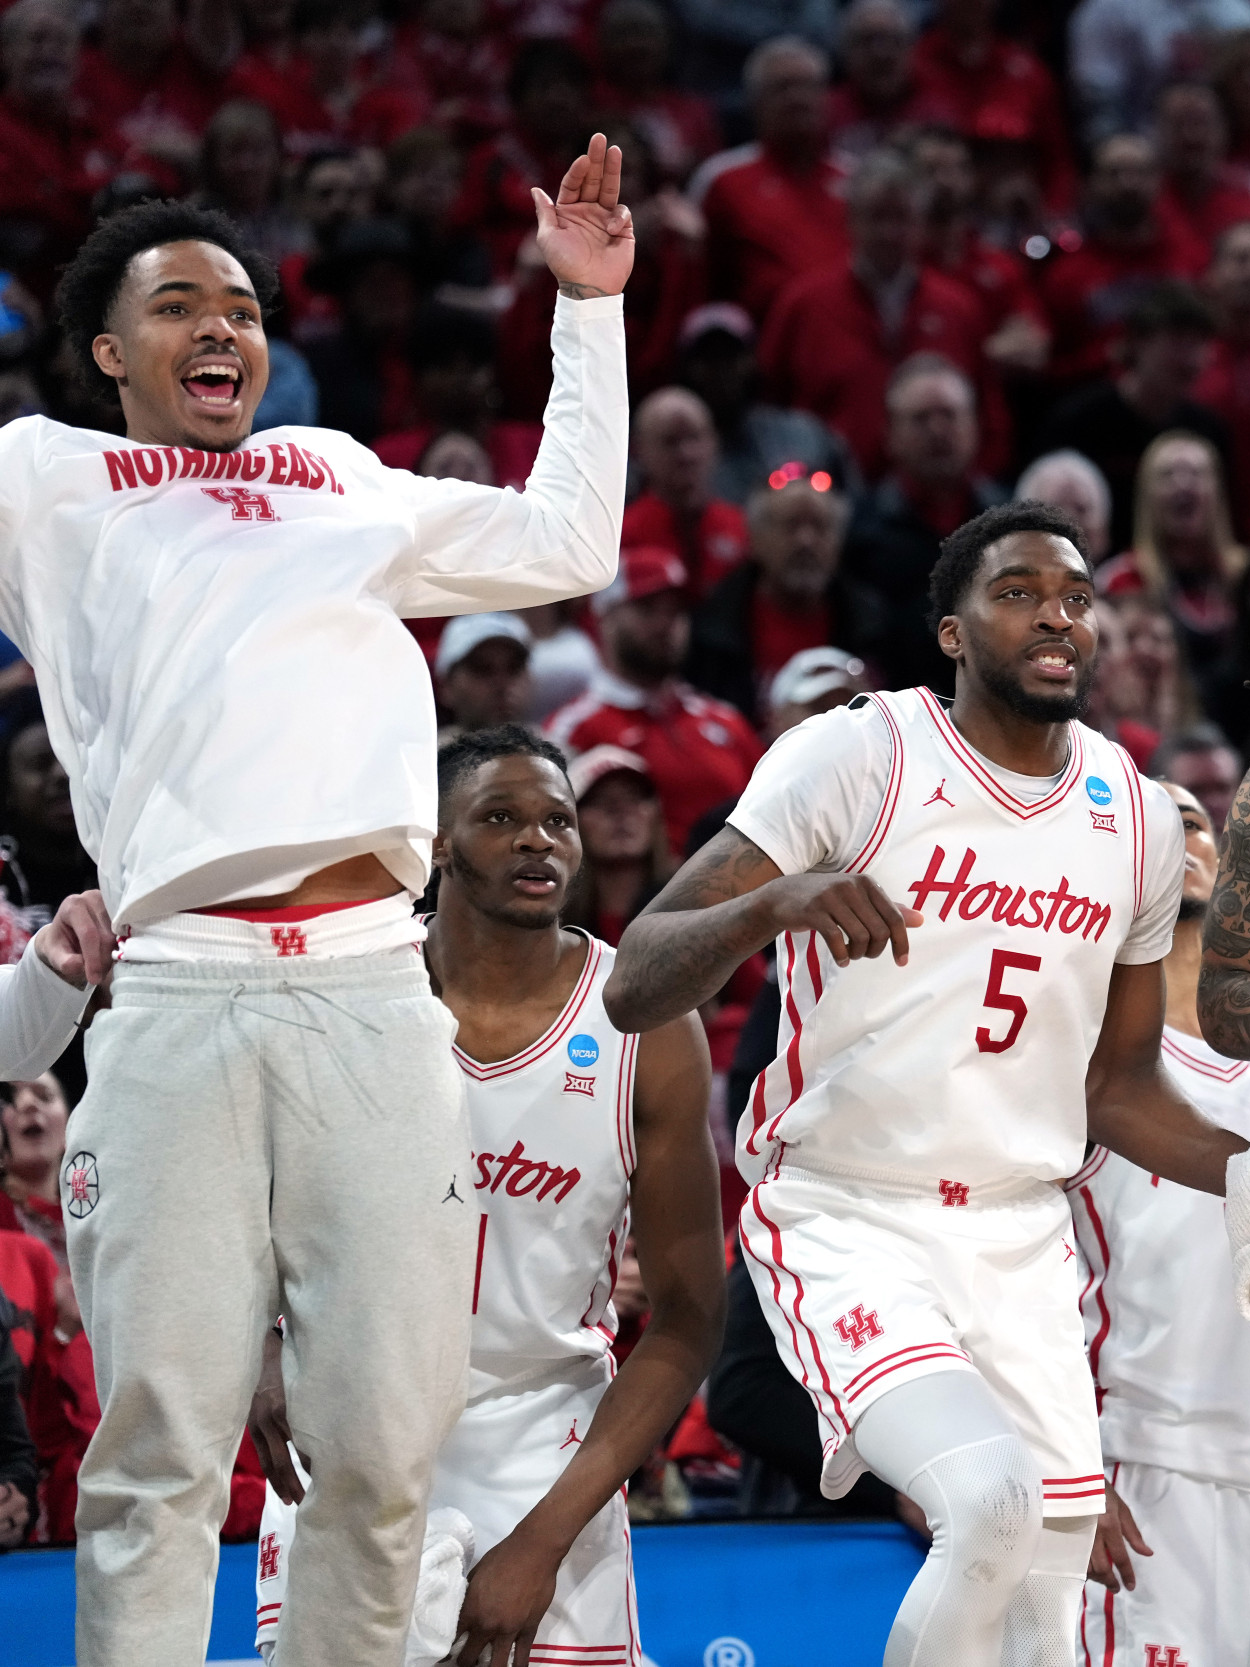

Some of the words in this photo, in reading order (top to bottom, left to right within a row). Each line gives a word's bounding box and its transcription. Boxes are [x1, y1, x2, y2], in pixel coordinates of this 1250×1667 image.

[102, 446, 266, 492] NOTHING
[200, 487, 276, 522] UH
[1089, 788, 1112, 799] NCAA
[907, 844, 1112, 944] Houston
[270, 926, 308, 957] UH
[975, 948, 1042, 1054] 5
[571, 1048, 597, 1059] NCAA
[472, 1140, 581, 1205] ston
[939, 1178, 970, 1207] UH
[832, 1303, 885, 1353] UH
